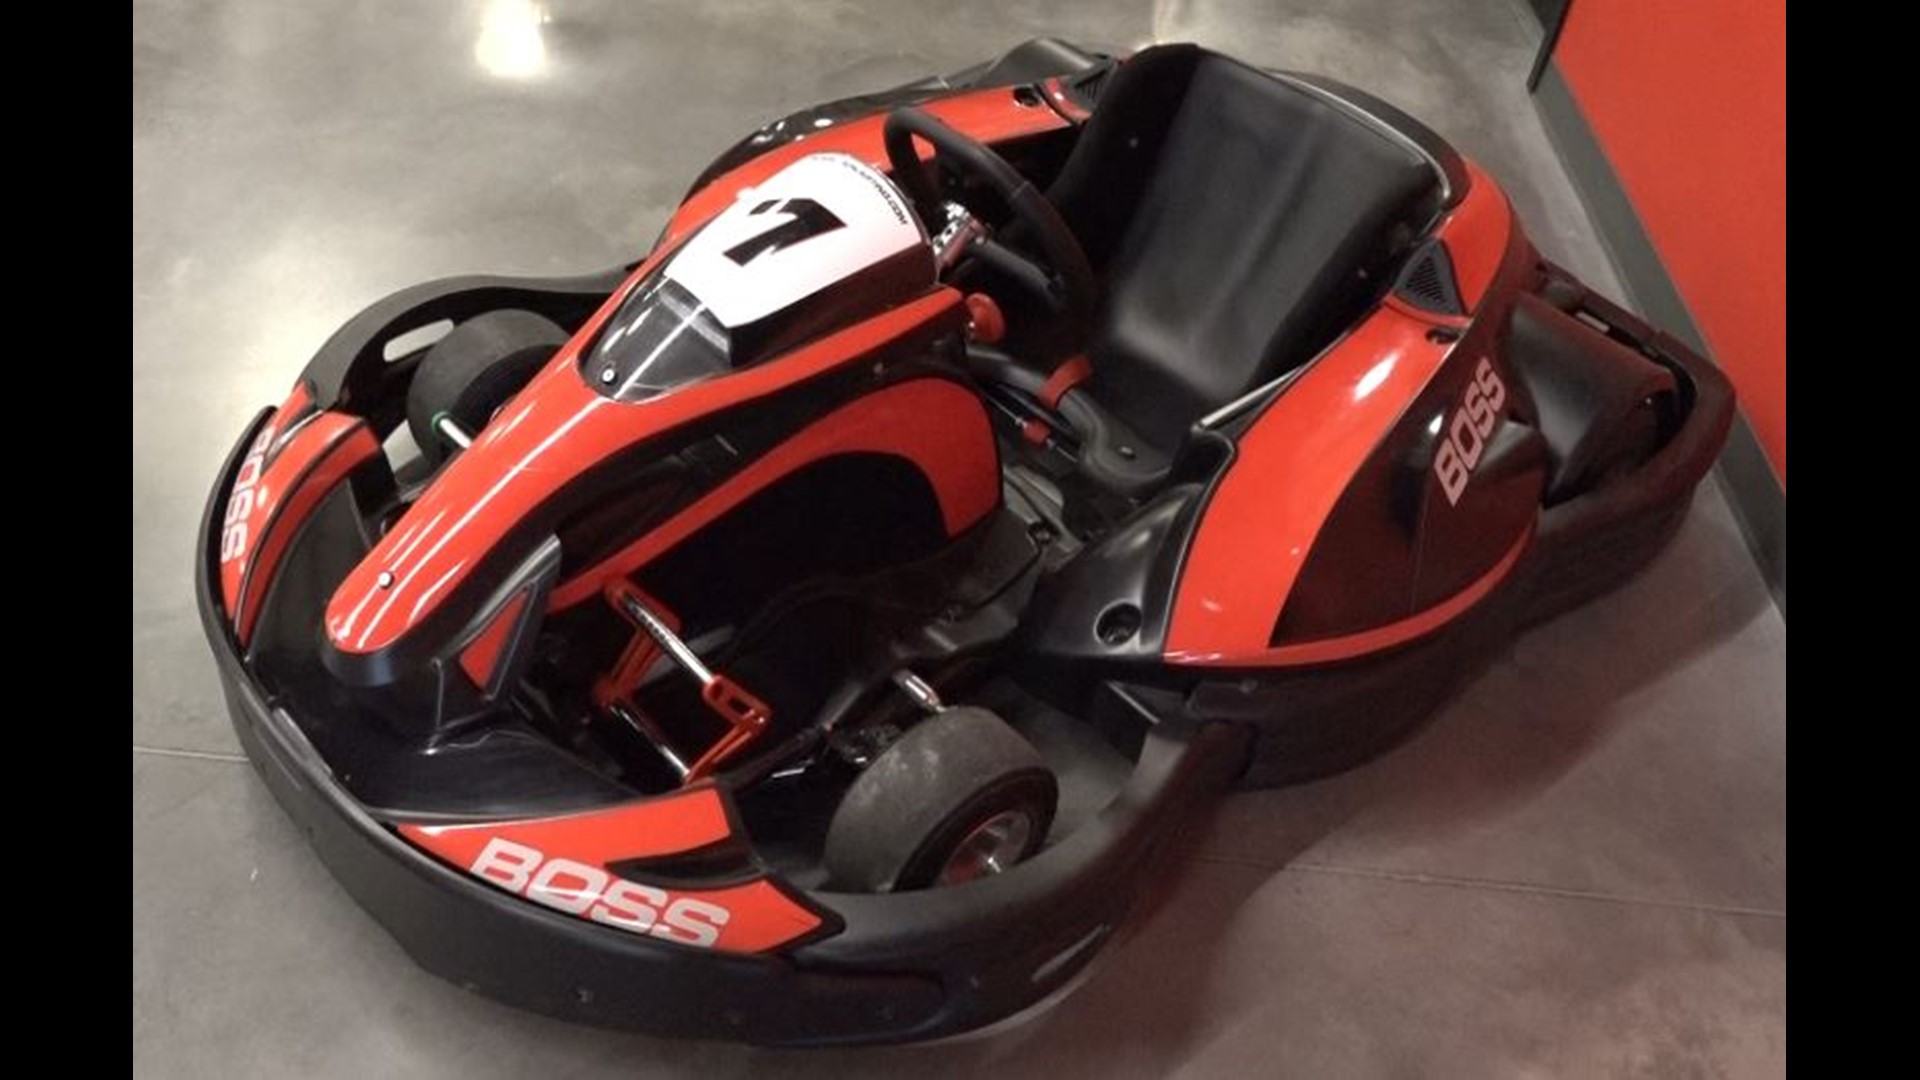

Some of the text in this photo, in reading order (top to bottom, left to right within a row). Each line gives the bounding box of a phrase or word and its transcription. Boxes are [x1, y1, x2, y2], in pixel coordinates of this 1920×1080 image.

[221, 425, 275, 564] BOSS
[1434, 357, 1505, 508] BOSS
[470, 837, 730, 947] BOSS
